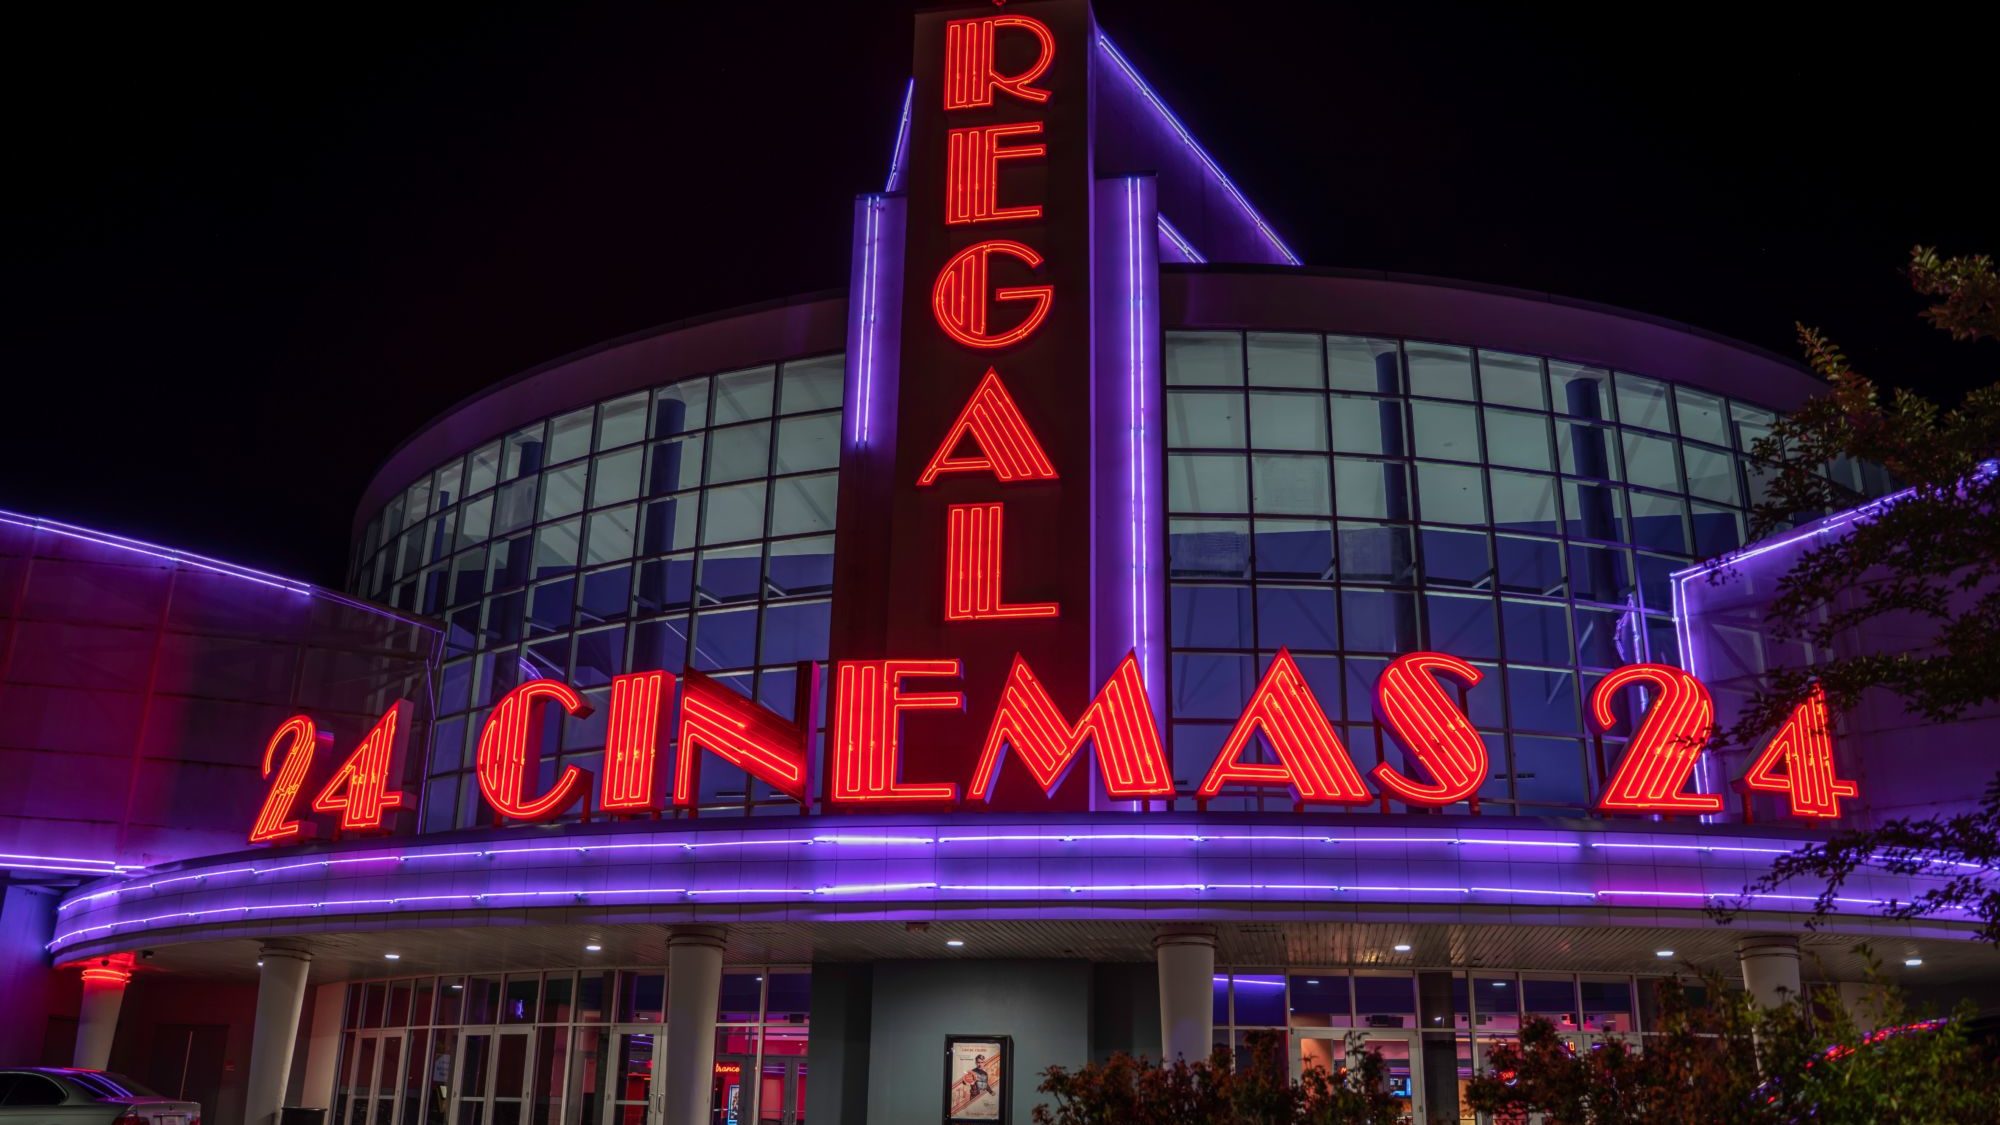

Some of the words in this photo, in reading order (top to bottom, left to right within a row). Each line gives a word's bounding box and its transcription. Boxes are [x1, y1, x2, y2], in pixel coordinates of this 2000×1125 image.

[917, 14, 1060, 622] REGAL
[247, 698, 404, 845] 24
[476, 646, 1488, 819] CINEMAS
[1593, 663, 1859, 819] 24
